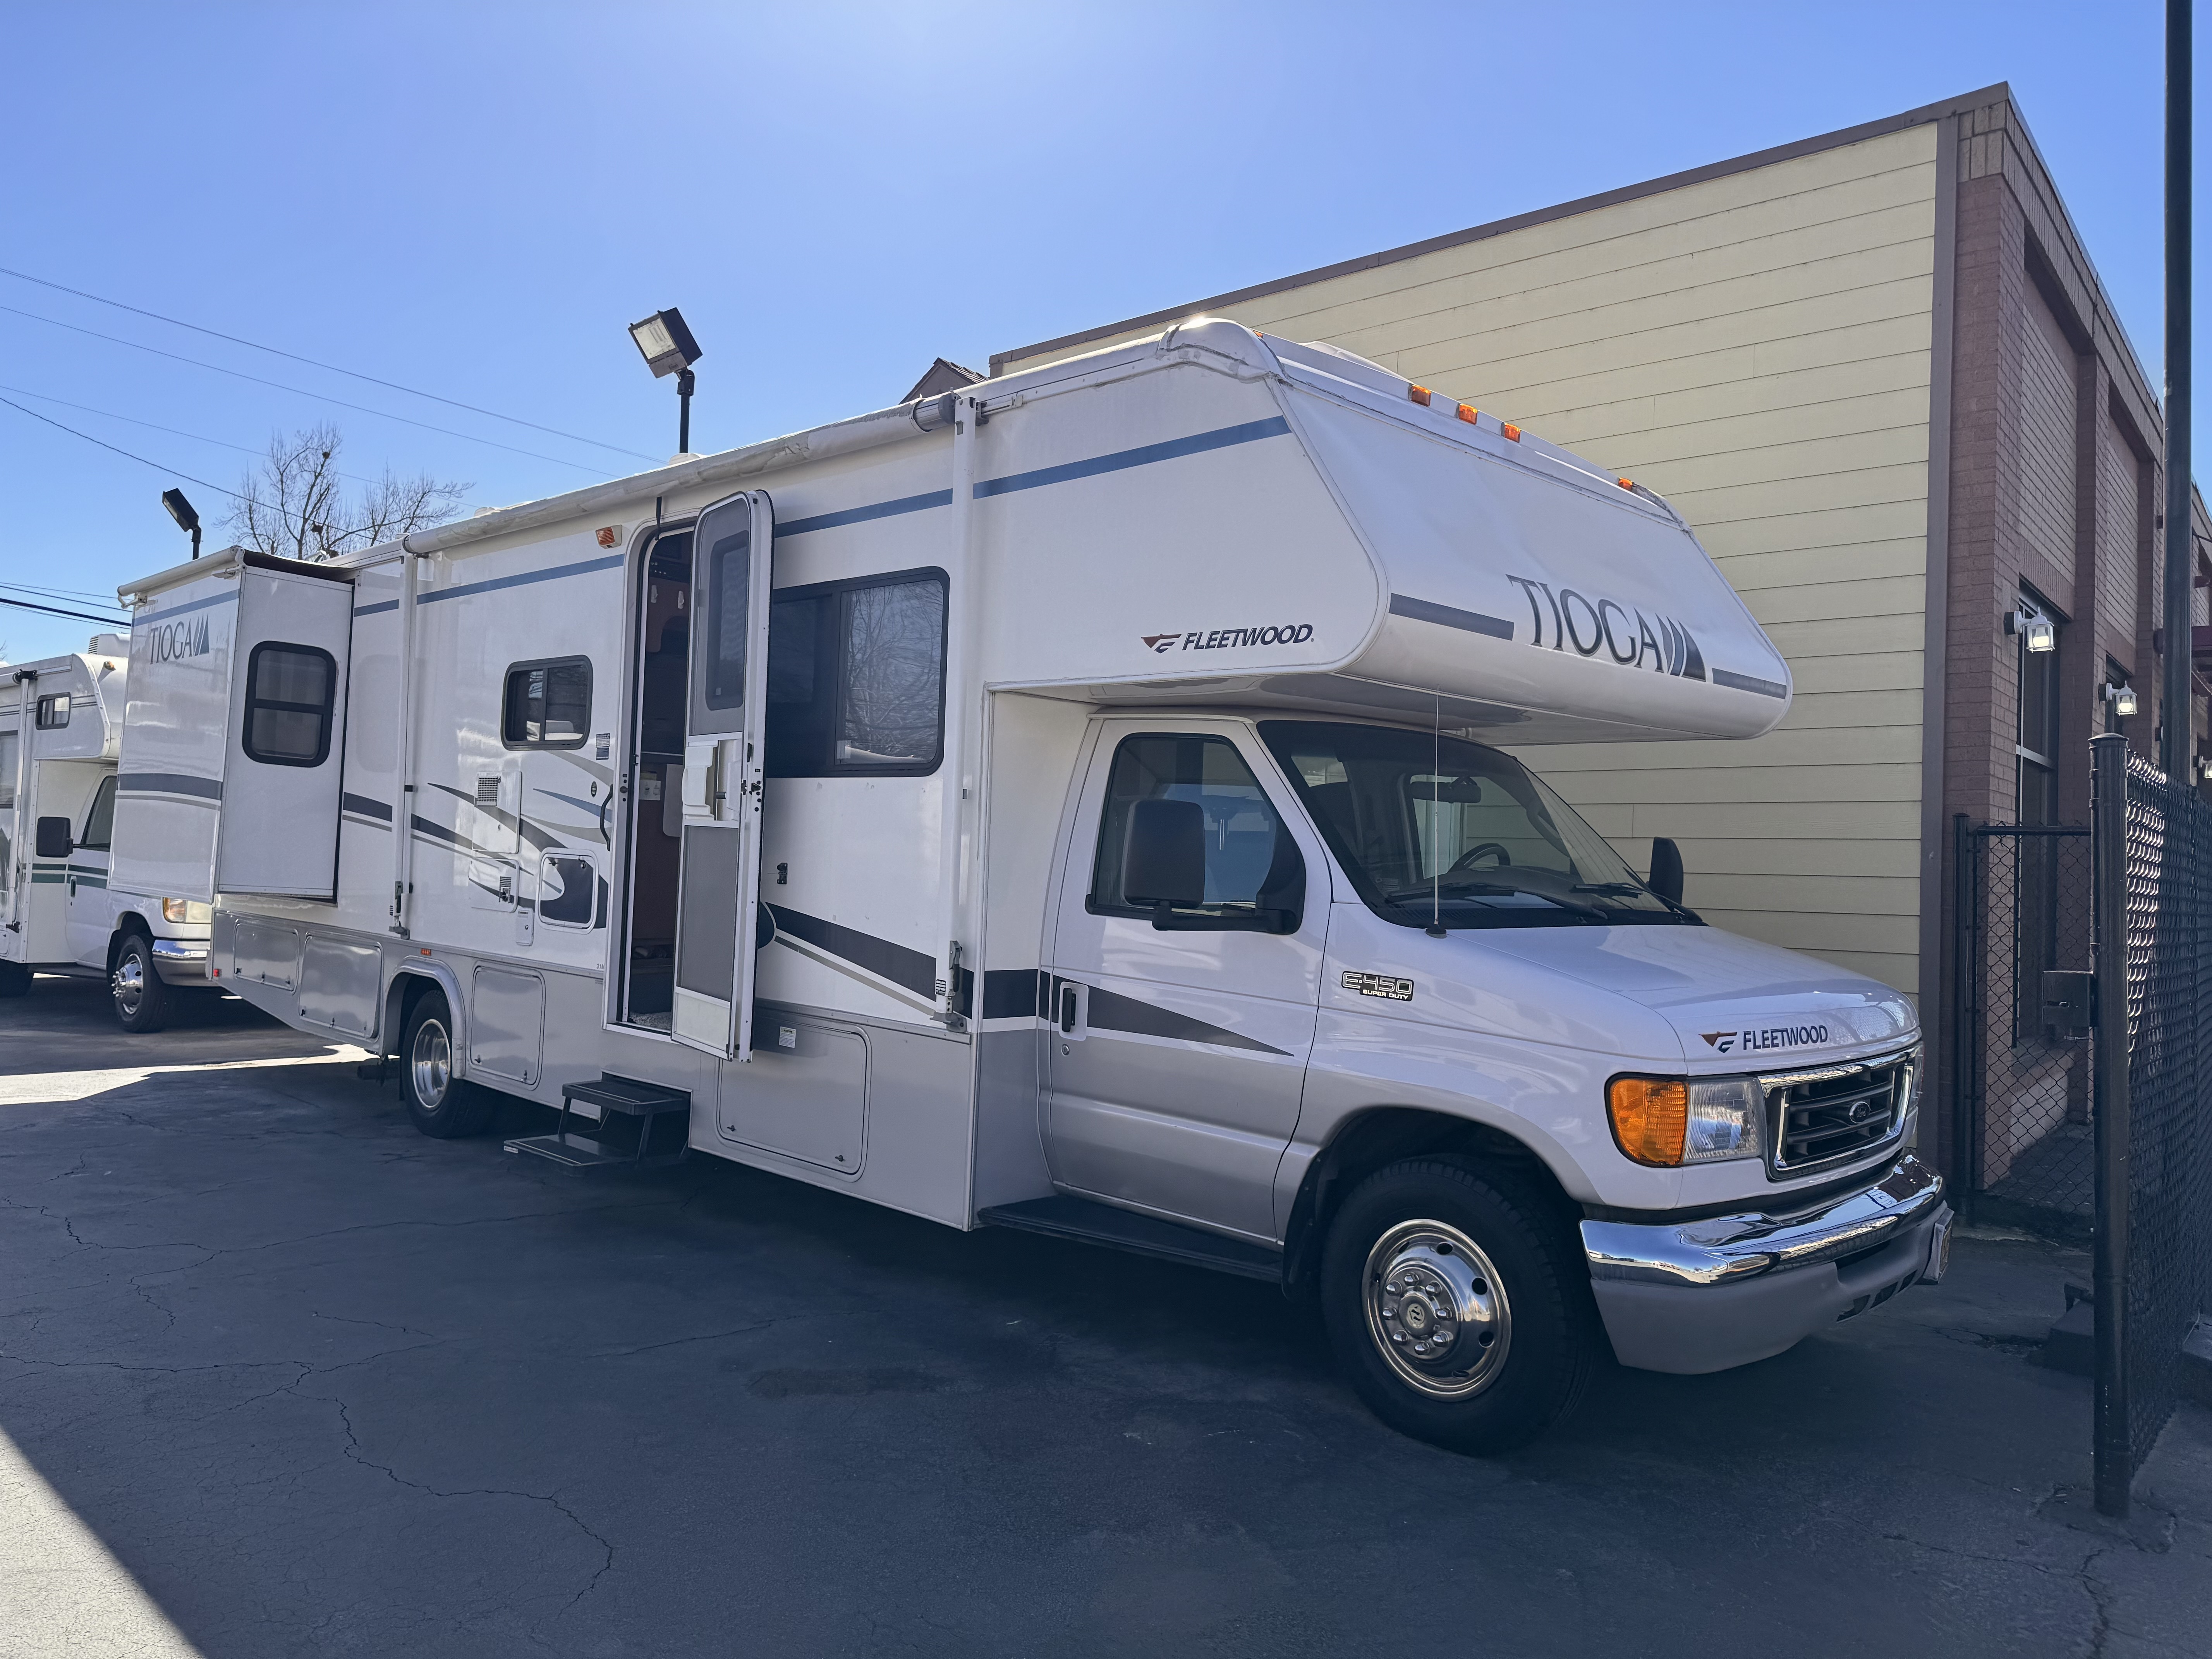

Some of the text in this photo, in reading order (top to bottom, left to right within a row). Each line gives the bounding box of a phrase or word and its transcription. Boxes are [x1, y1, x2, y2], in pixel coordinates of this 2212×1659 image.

[1505, 574, 1664, 673] TIOGA
[150, 618, 192, 665] TIOGA
[1182, 624, 1313, 651] FLEETWOOD
[1363, 989, 1386, 997] SUPER
[1743, 1025, 1828, 1050] FLEETWOOD
